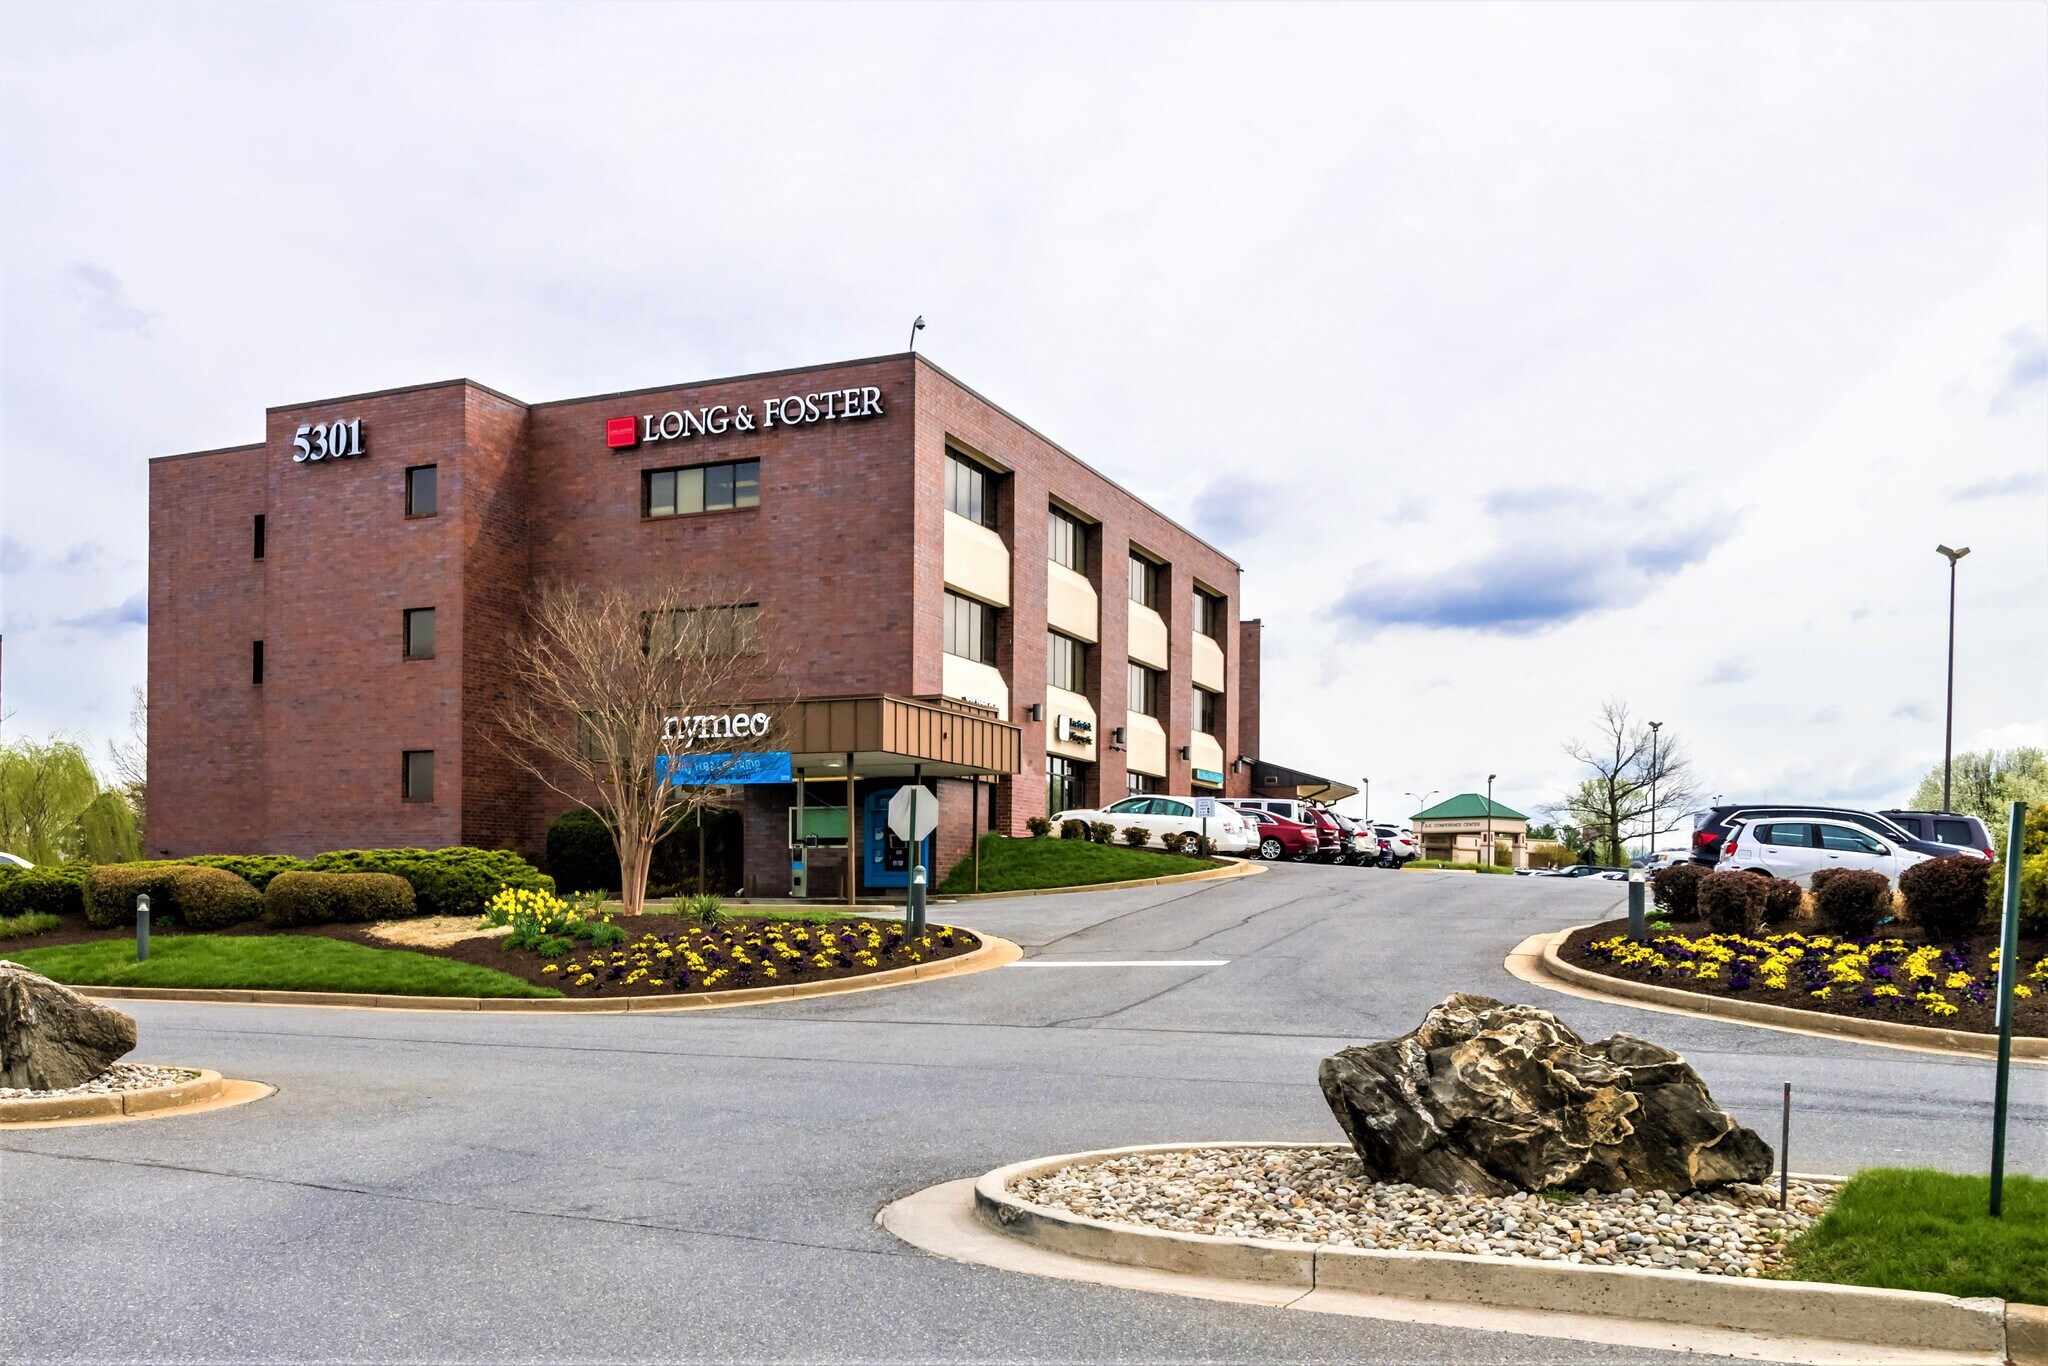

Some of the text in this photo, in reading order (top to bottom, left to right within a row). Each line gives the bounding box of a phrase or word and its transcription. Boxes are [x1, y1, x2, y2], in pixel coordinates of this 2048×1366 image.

[643, 386, 884, 442] LONG & FOSTER
[292, 418, 363, 463] 5301
[661, 712, 771, 748] nymeo
